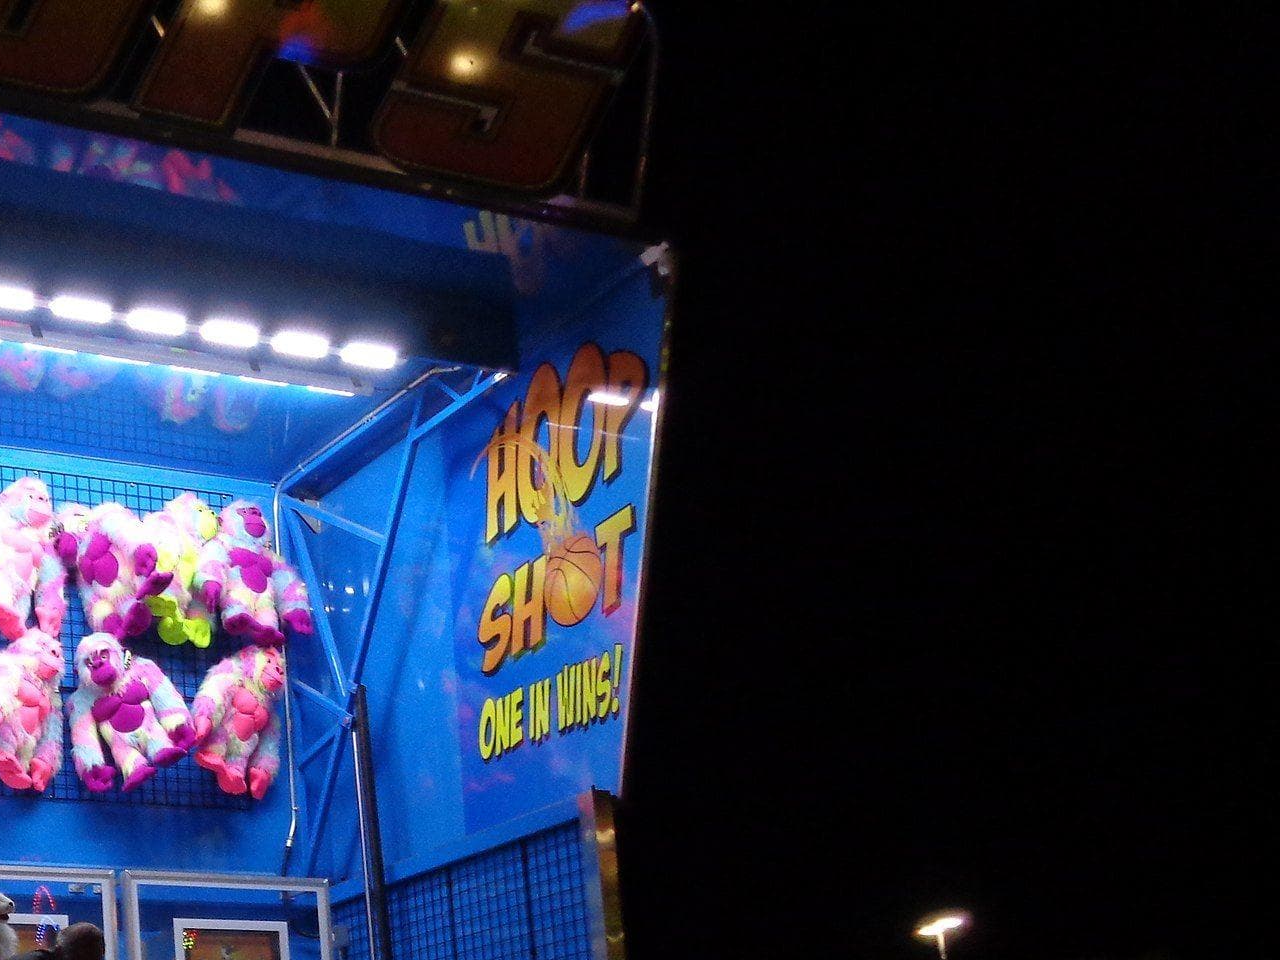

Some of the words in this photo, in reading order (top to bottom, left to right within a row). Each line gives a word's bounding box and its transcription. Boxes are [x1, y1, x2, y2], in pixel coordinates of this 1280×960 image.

[485, 343, 649, 543] HOOP
[477, 504, 637, 676] SHOT
[477, 688, 524, 764] ONE
[528, 677, 552, 744] IN
[557, 644, 624, 736] WINS!
